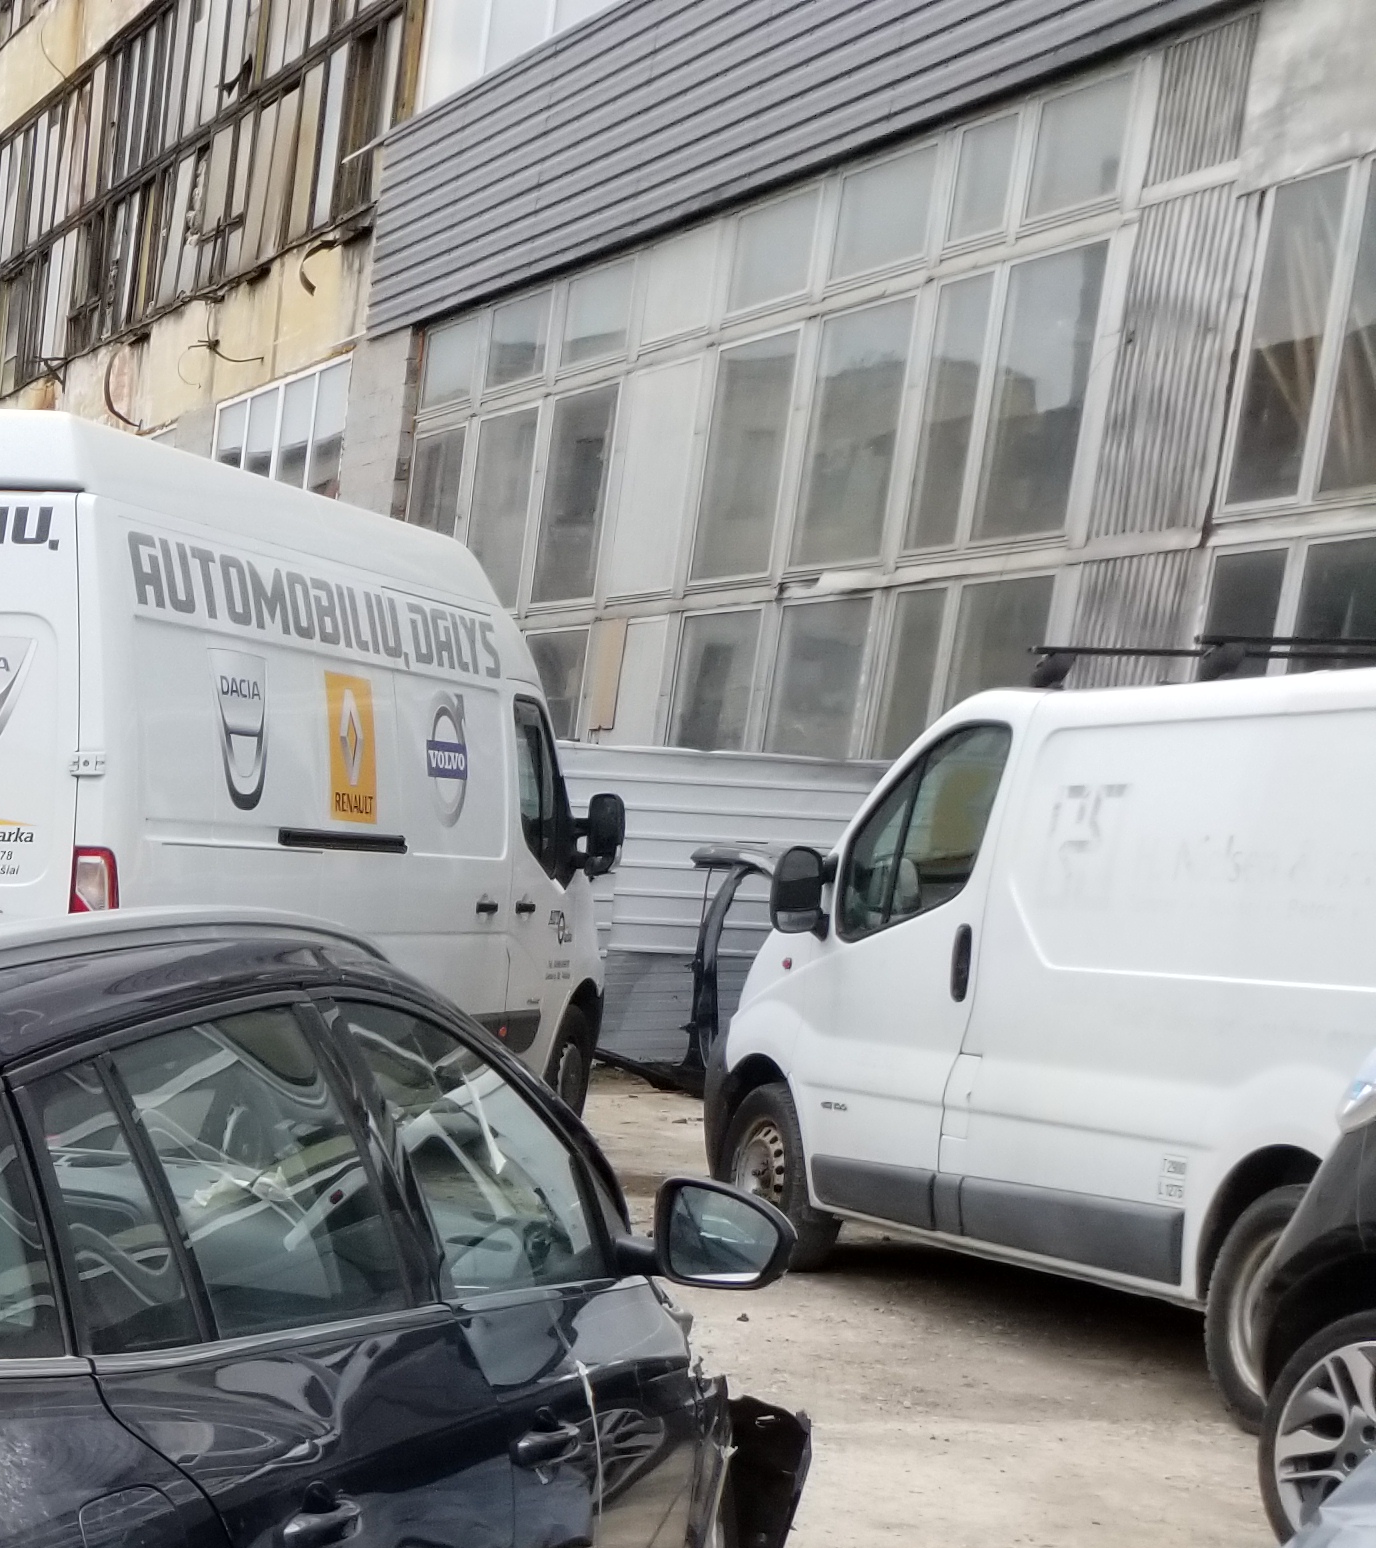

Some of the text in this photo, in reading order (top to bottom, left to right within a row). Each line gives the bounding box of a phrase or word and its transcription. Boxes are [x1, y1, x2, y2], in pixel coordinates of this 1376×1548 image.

[406, 601, 501, 680] DALYS
[219, 675, 261, 700] DACIA
[428, 750, 465, 771] VOLVO
[335, 792, 373, 816] RENAULT
